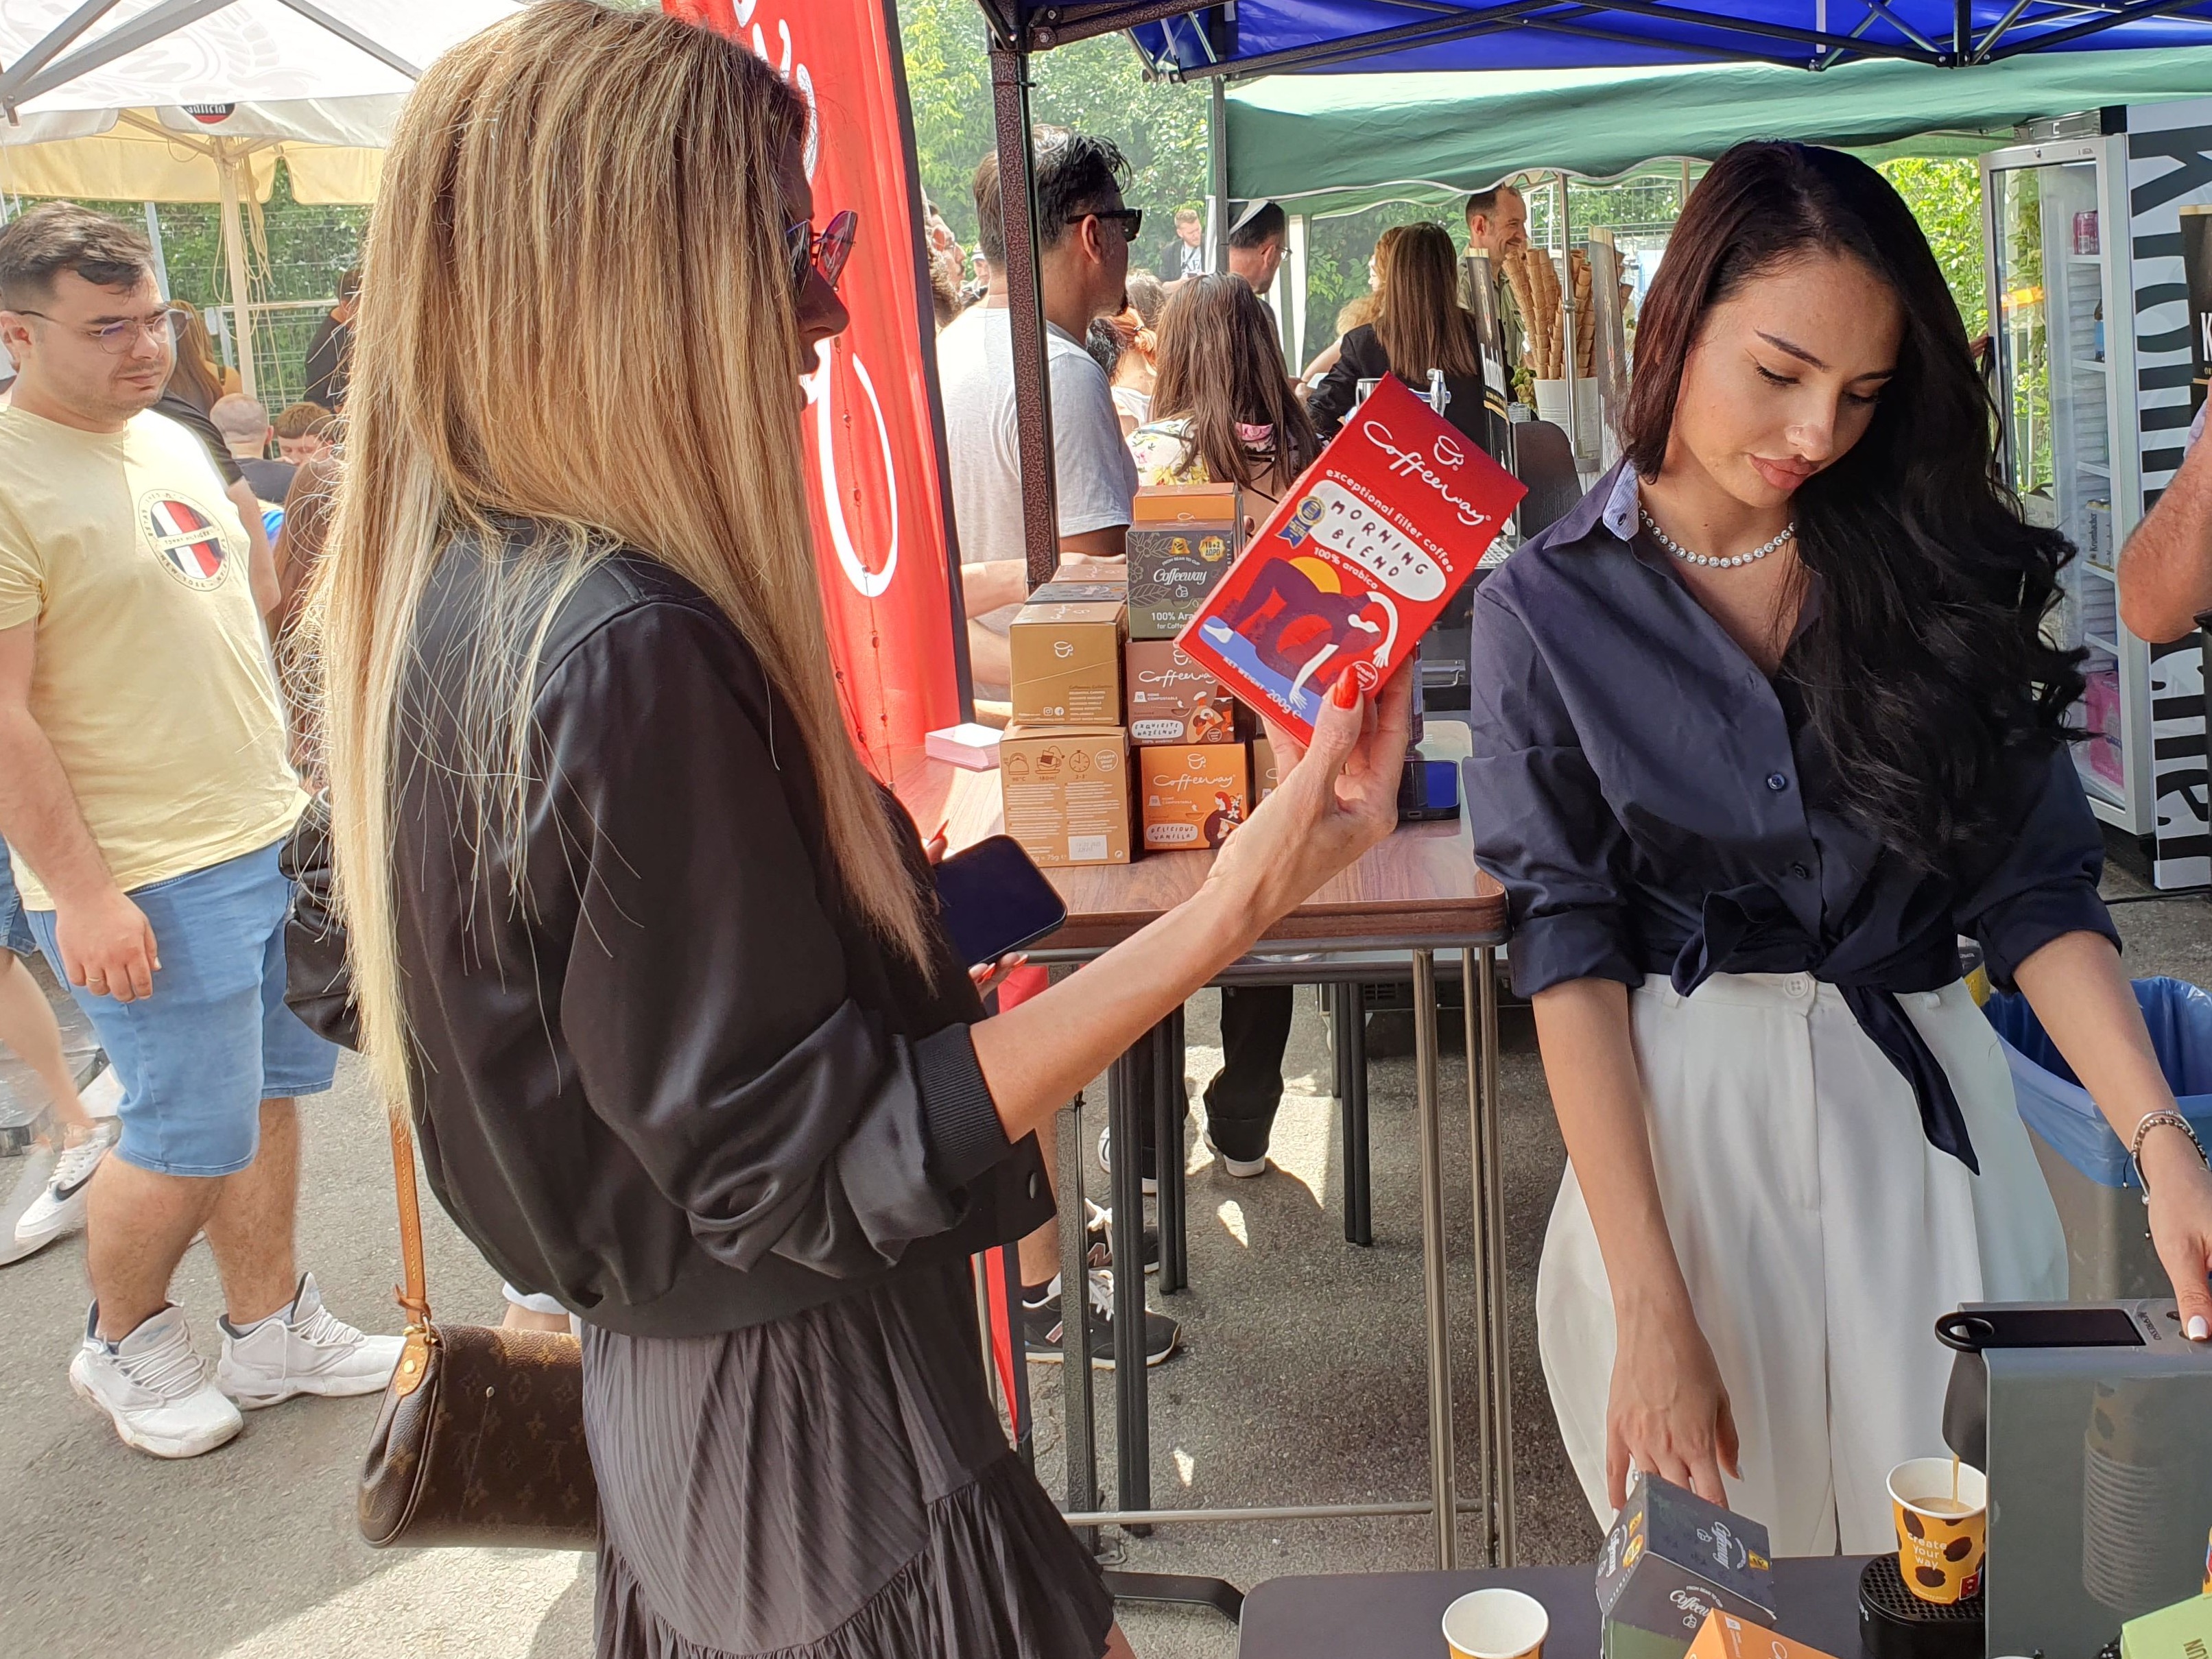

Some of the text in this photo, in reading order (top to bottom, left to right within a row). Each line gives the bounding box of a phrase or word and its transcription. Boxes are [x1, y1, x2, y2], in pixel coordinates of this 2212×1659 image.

[1363, 420, 1486, 526] Coffeeway
[1326, 469, 1395, 516] exceptional
[1394, 512, 1423, 539] filter
[1423, 538, 1454, 573] coffee
[1331, 501, 1429, 575] MORNING
[1331, 529, 1399, 577] BLEND
[1154, 568, 1207, 585] Coffeeway
[1313, 547, 1379, 590] 100% arabica
[1151, 612, 1176, 621] 100%
[1266, 689, 1292, 714] 200g
[1154, 774, 1233, 792] Coffeeway
[1907, 1532, 1947, 1550] create
[1913, 1544, 1940, 1559] your
[1915, 1555, 1938, 1571] way
[1669, 1590, 1713, 1617] Coffeew
